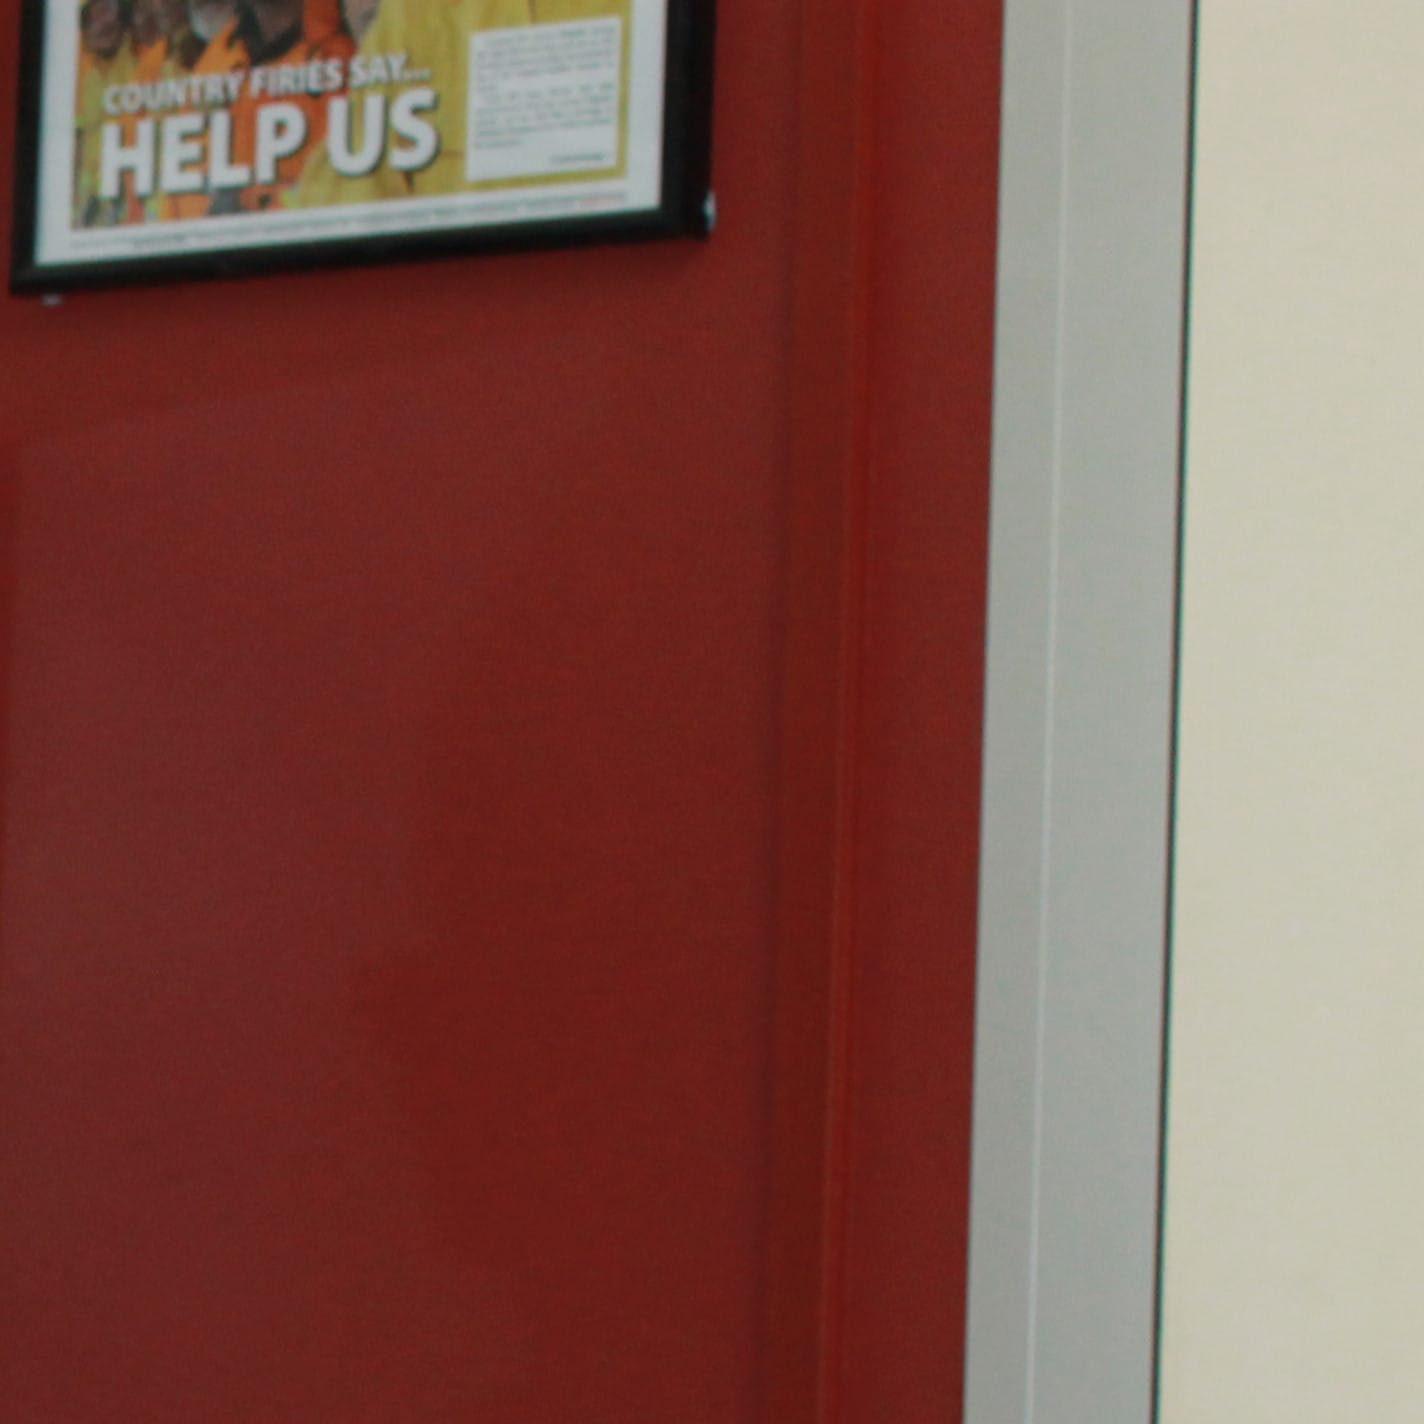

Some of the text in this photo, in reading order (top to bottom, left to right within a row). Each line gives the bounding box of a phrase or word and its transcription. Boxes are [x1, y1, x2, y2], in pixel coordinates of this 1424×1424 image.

[103, 72, 243, 116] COUNTRY
[251, 57, 343, 98] FIRIES
[101, 103, 307, 199] HELP
[327, 88, 440, 177] US
